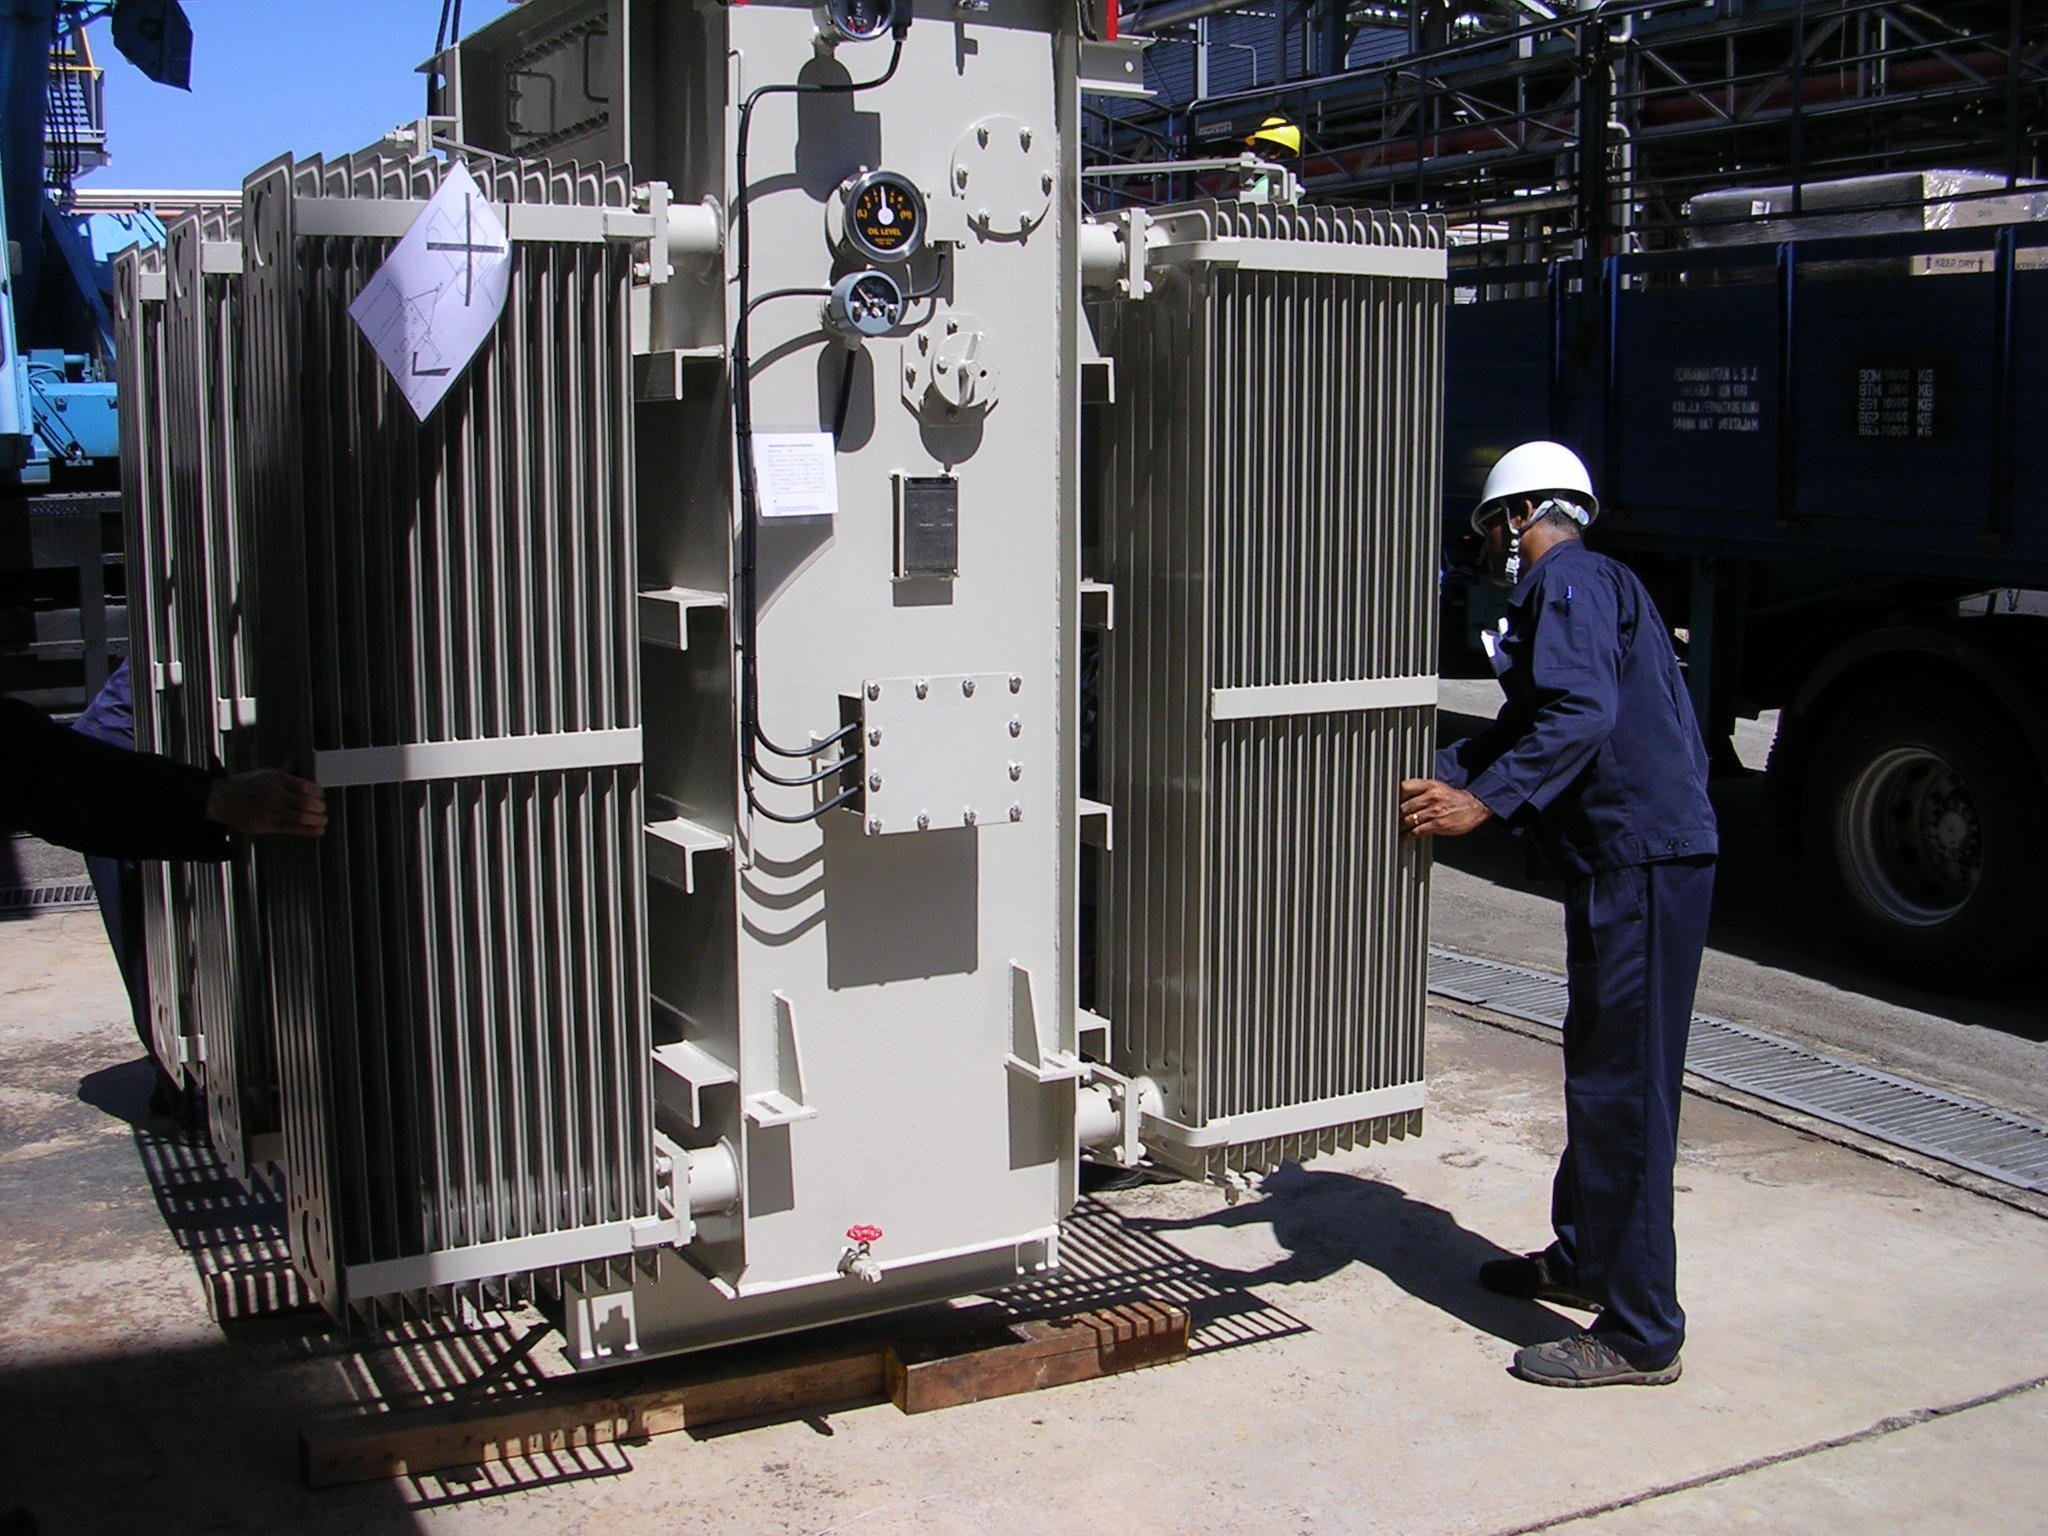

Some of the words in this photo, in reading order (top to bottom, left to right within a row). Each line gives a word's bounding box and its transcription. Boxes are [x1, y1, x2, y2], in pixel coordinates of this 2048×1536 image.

[867, 226, 880, 236] OIL
[880, 227, 902, 236] LEVEL
[1935, 256, 1957, 268] KEEP
[1958, 258, 1976, 269] DRY
[1918, 369, 1933, 383] KG
[1859, 383, 1882, 397] BTM
[1918, 383, 1934, 397] KG
[1917, 398, 1933, 411] KG
[1858, 411, 1879, 424] BG2
[1917, 412, 1932, 425] KG
[1917, 425, 1932, 437] KG
